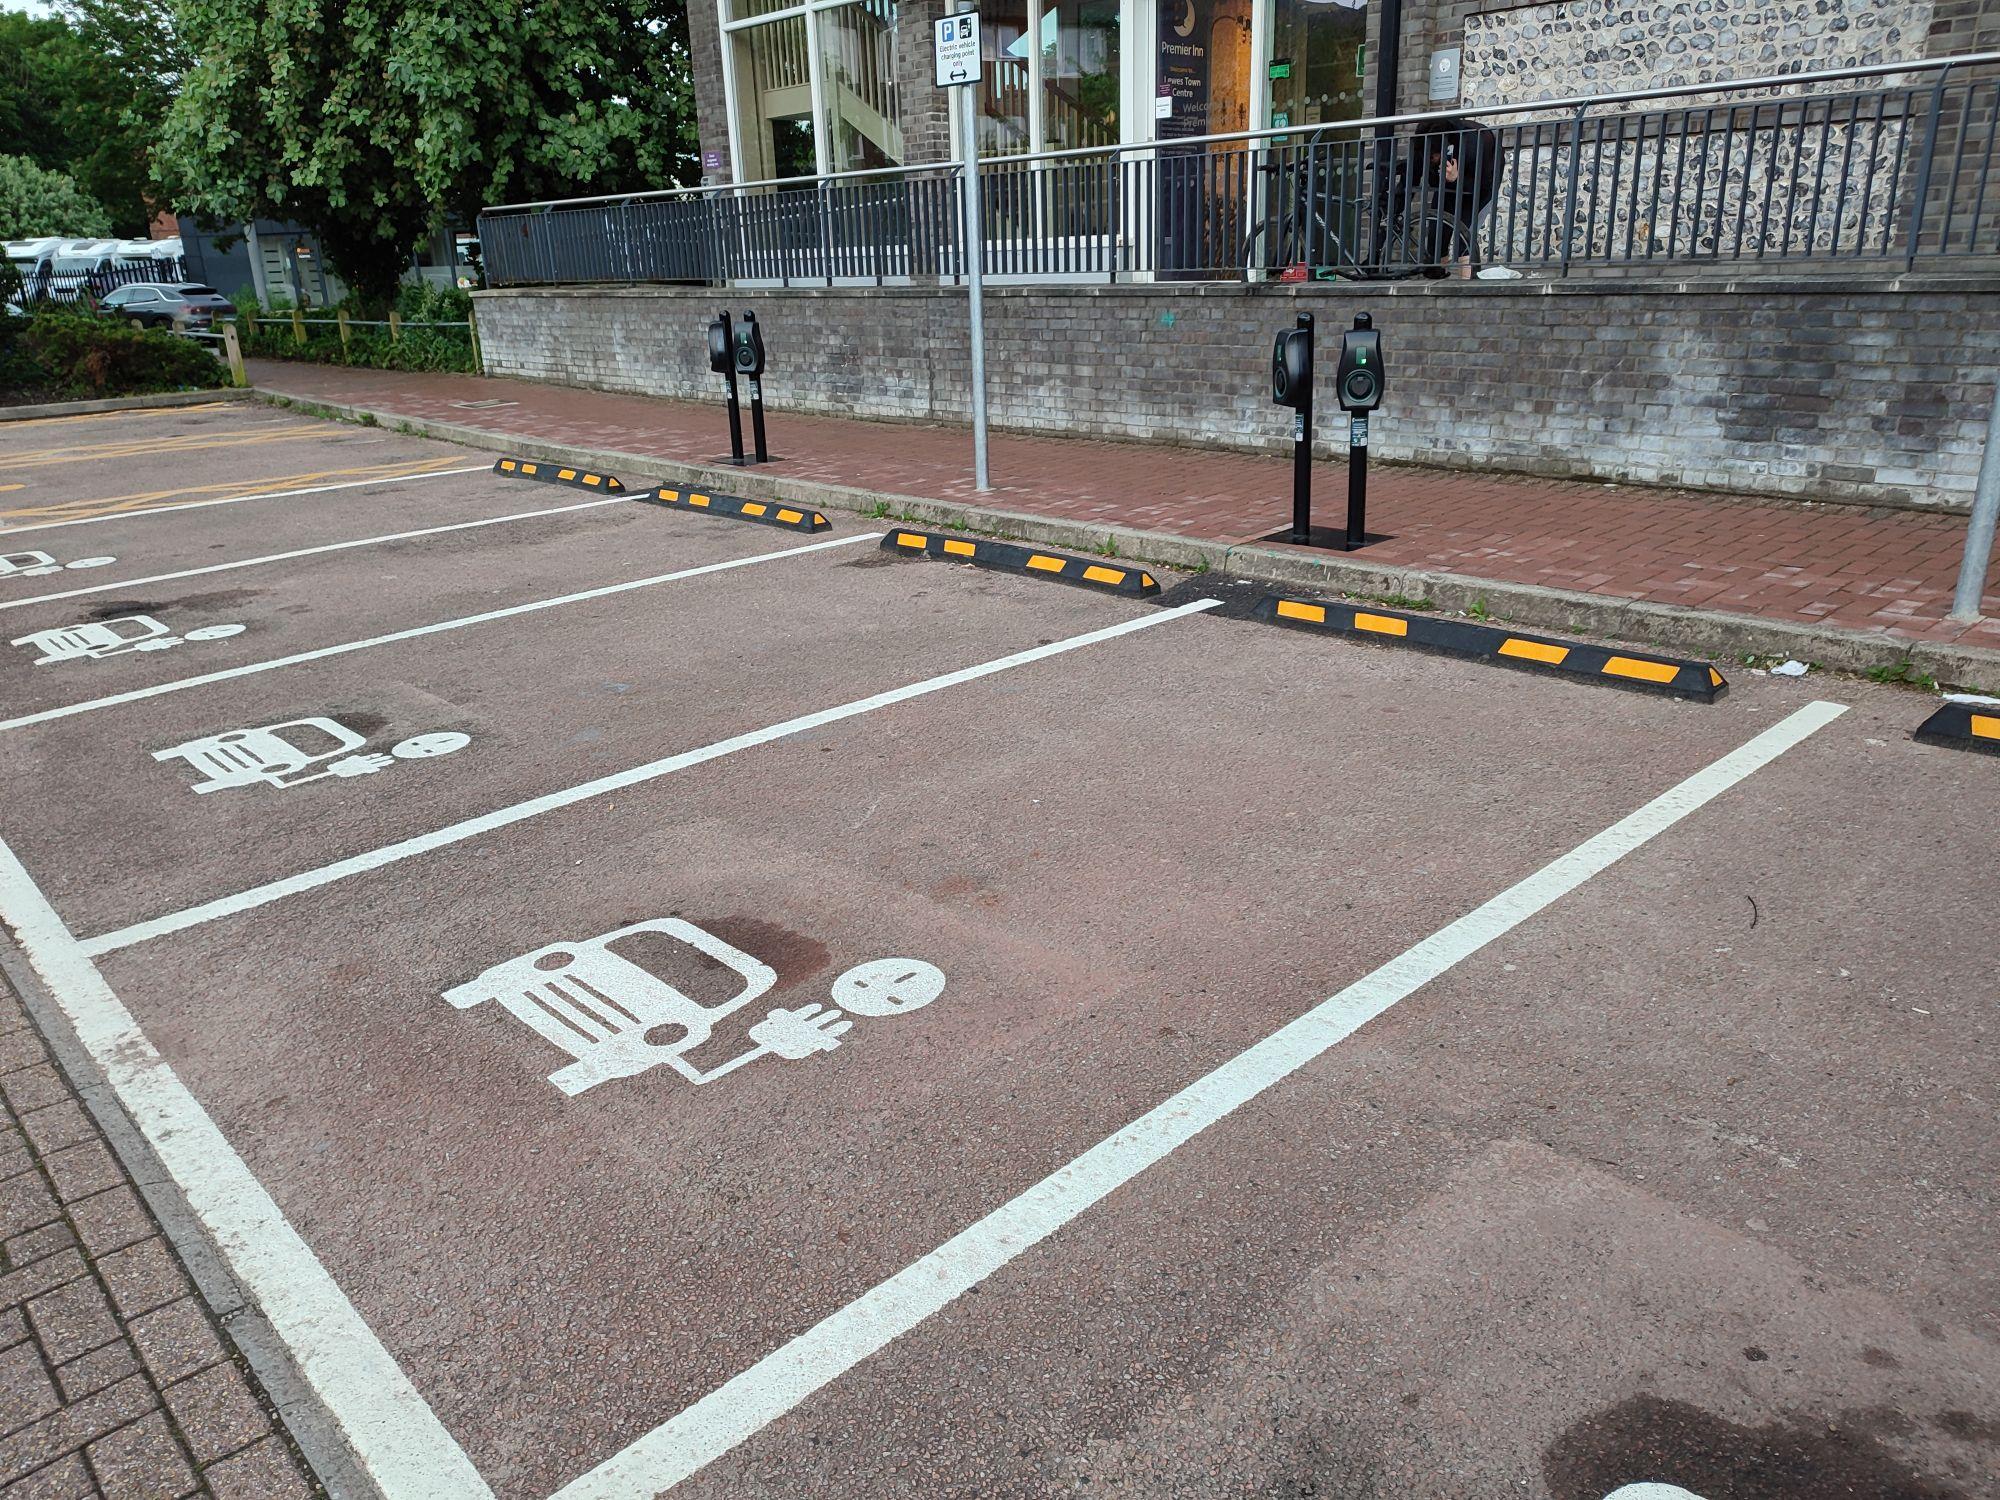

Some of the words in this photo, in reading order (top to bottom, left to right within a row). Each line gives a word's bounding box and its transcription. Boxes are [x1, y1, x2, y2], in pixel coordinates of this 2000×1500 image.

[944, 23, 952, 41] P
[940, 44, 957, 53] Electric
[959, 41, 975, 49] vehicle
[1161, 41, 1192, 56] Premier
[1192, 44, 1204, 57] Inn
[941, 52, 961, 61] charging
[962, 49, 974, 57] point
[1184, 77, 1201, 87] Town
[1172, 88, 1194, 98] Centre
